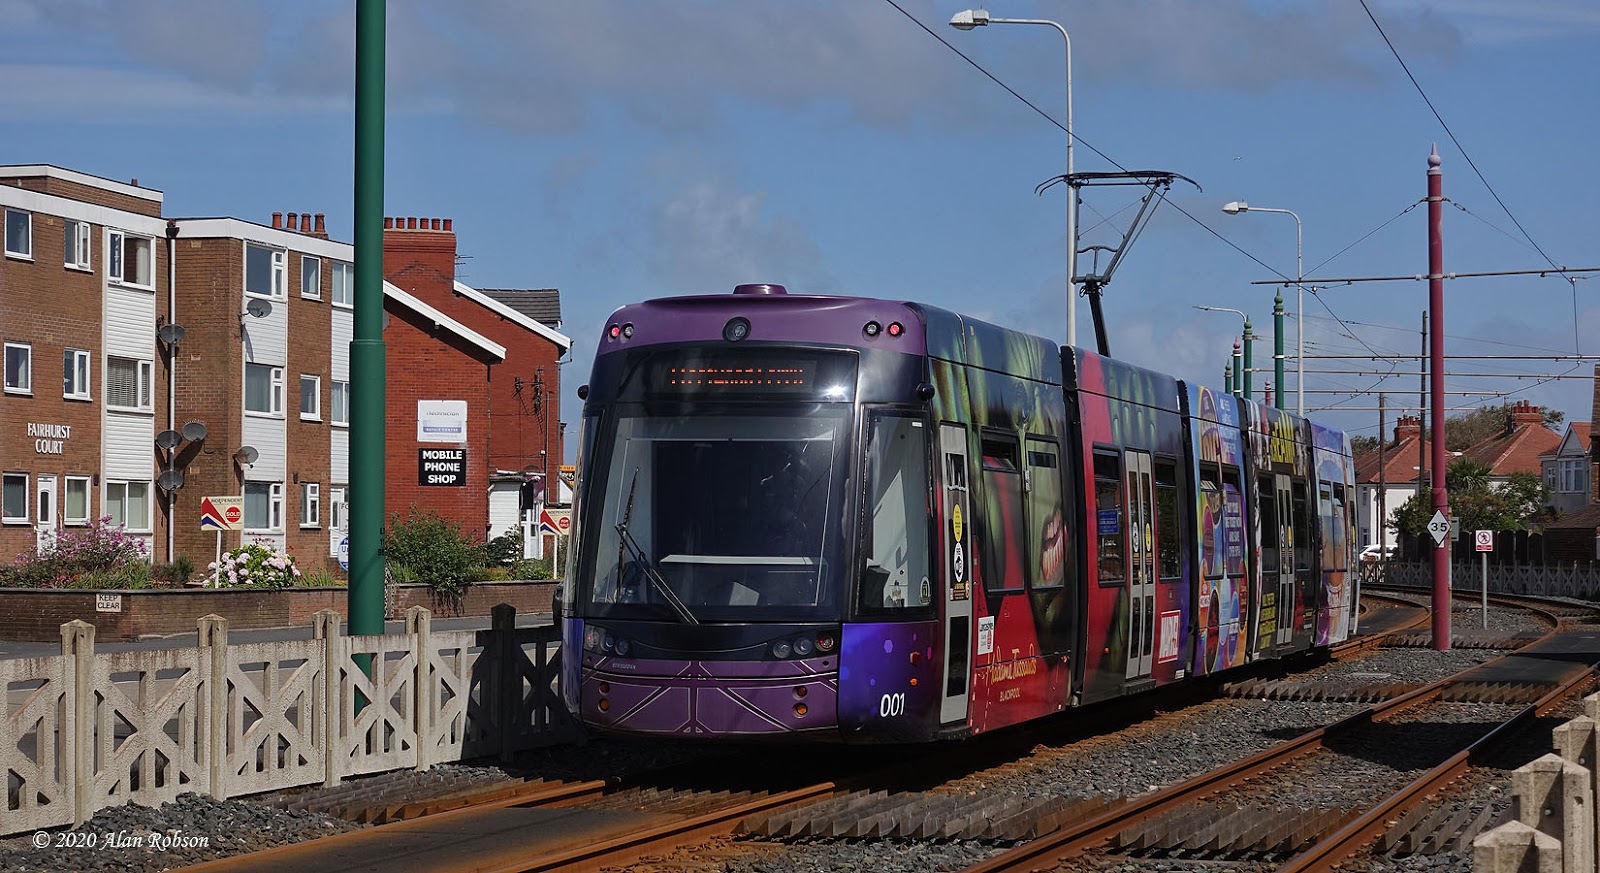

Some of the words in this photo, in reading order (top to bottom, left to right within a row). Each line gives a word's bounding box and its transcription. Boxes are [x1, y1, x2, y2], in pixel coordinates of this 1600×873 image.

[27, 422, 71, 439] FAIRHURST
[35, 438, 64, 454] COURT
[422, 450, 463, 460] MOBILE
[424, 462, 461, 472] PHONE
[427, 474, 457, 484] SHOP
[1431, 522, 1448, 532] 35
[880, 692, 905, 718] 001
